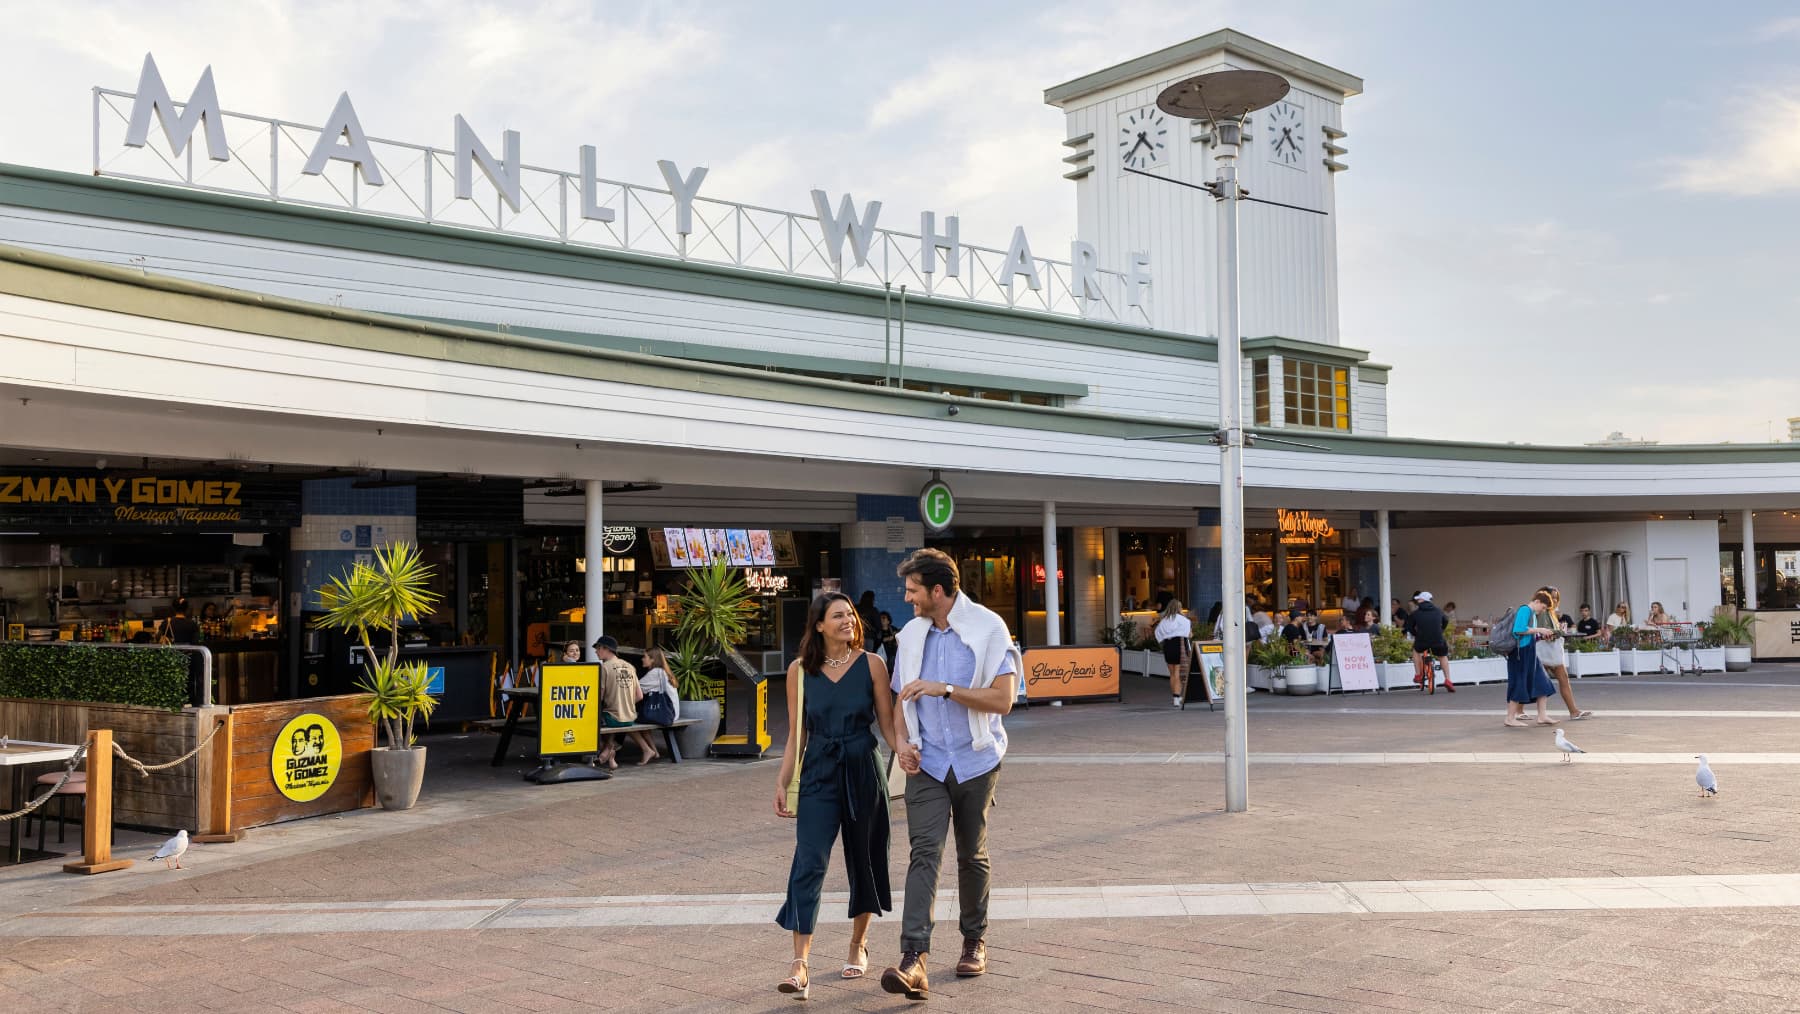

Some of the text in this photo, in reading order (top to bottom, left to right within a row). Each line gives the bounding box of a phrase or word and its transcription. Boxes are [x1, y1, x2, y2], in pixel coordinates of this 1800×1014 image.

[124, 51, 1152, 307] MANLY WHARF
[0, 476, 241, 505] ZMAN Y GOMEZ
[114, 506, 176, 521] Mexican
[935, 494, 944, 518] F
[1790, 620, 1800, 644] THE
[1029, 661, 1096, 685] Gloria Jean's
[551, 685, 590, 701] ENTRY
[554, 703, 586, 719] ONLY
[286, 754, 328, 770] GUZMAN
[286, 766, 328, 782] Y GOMEZ
